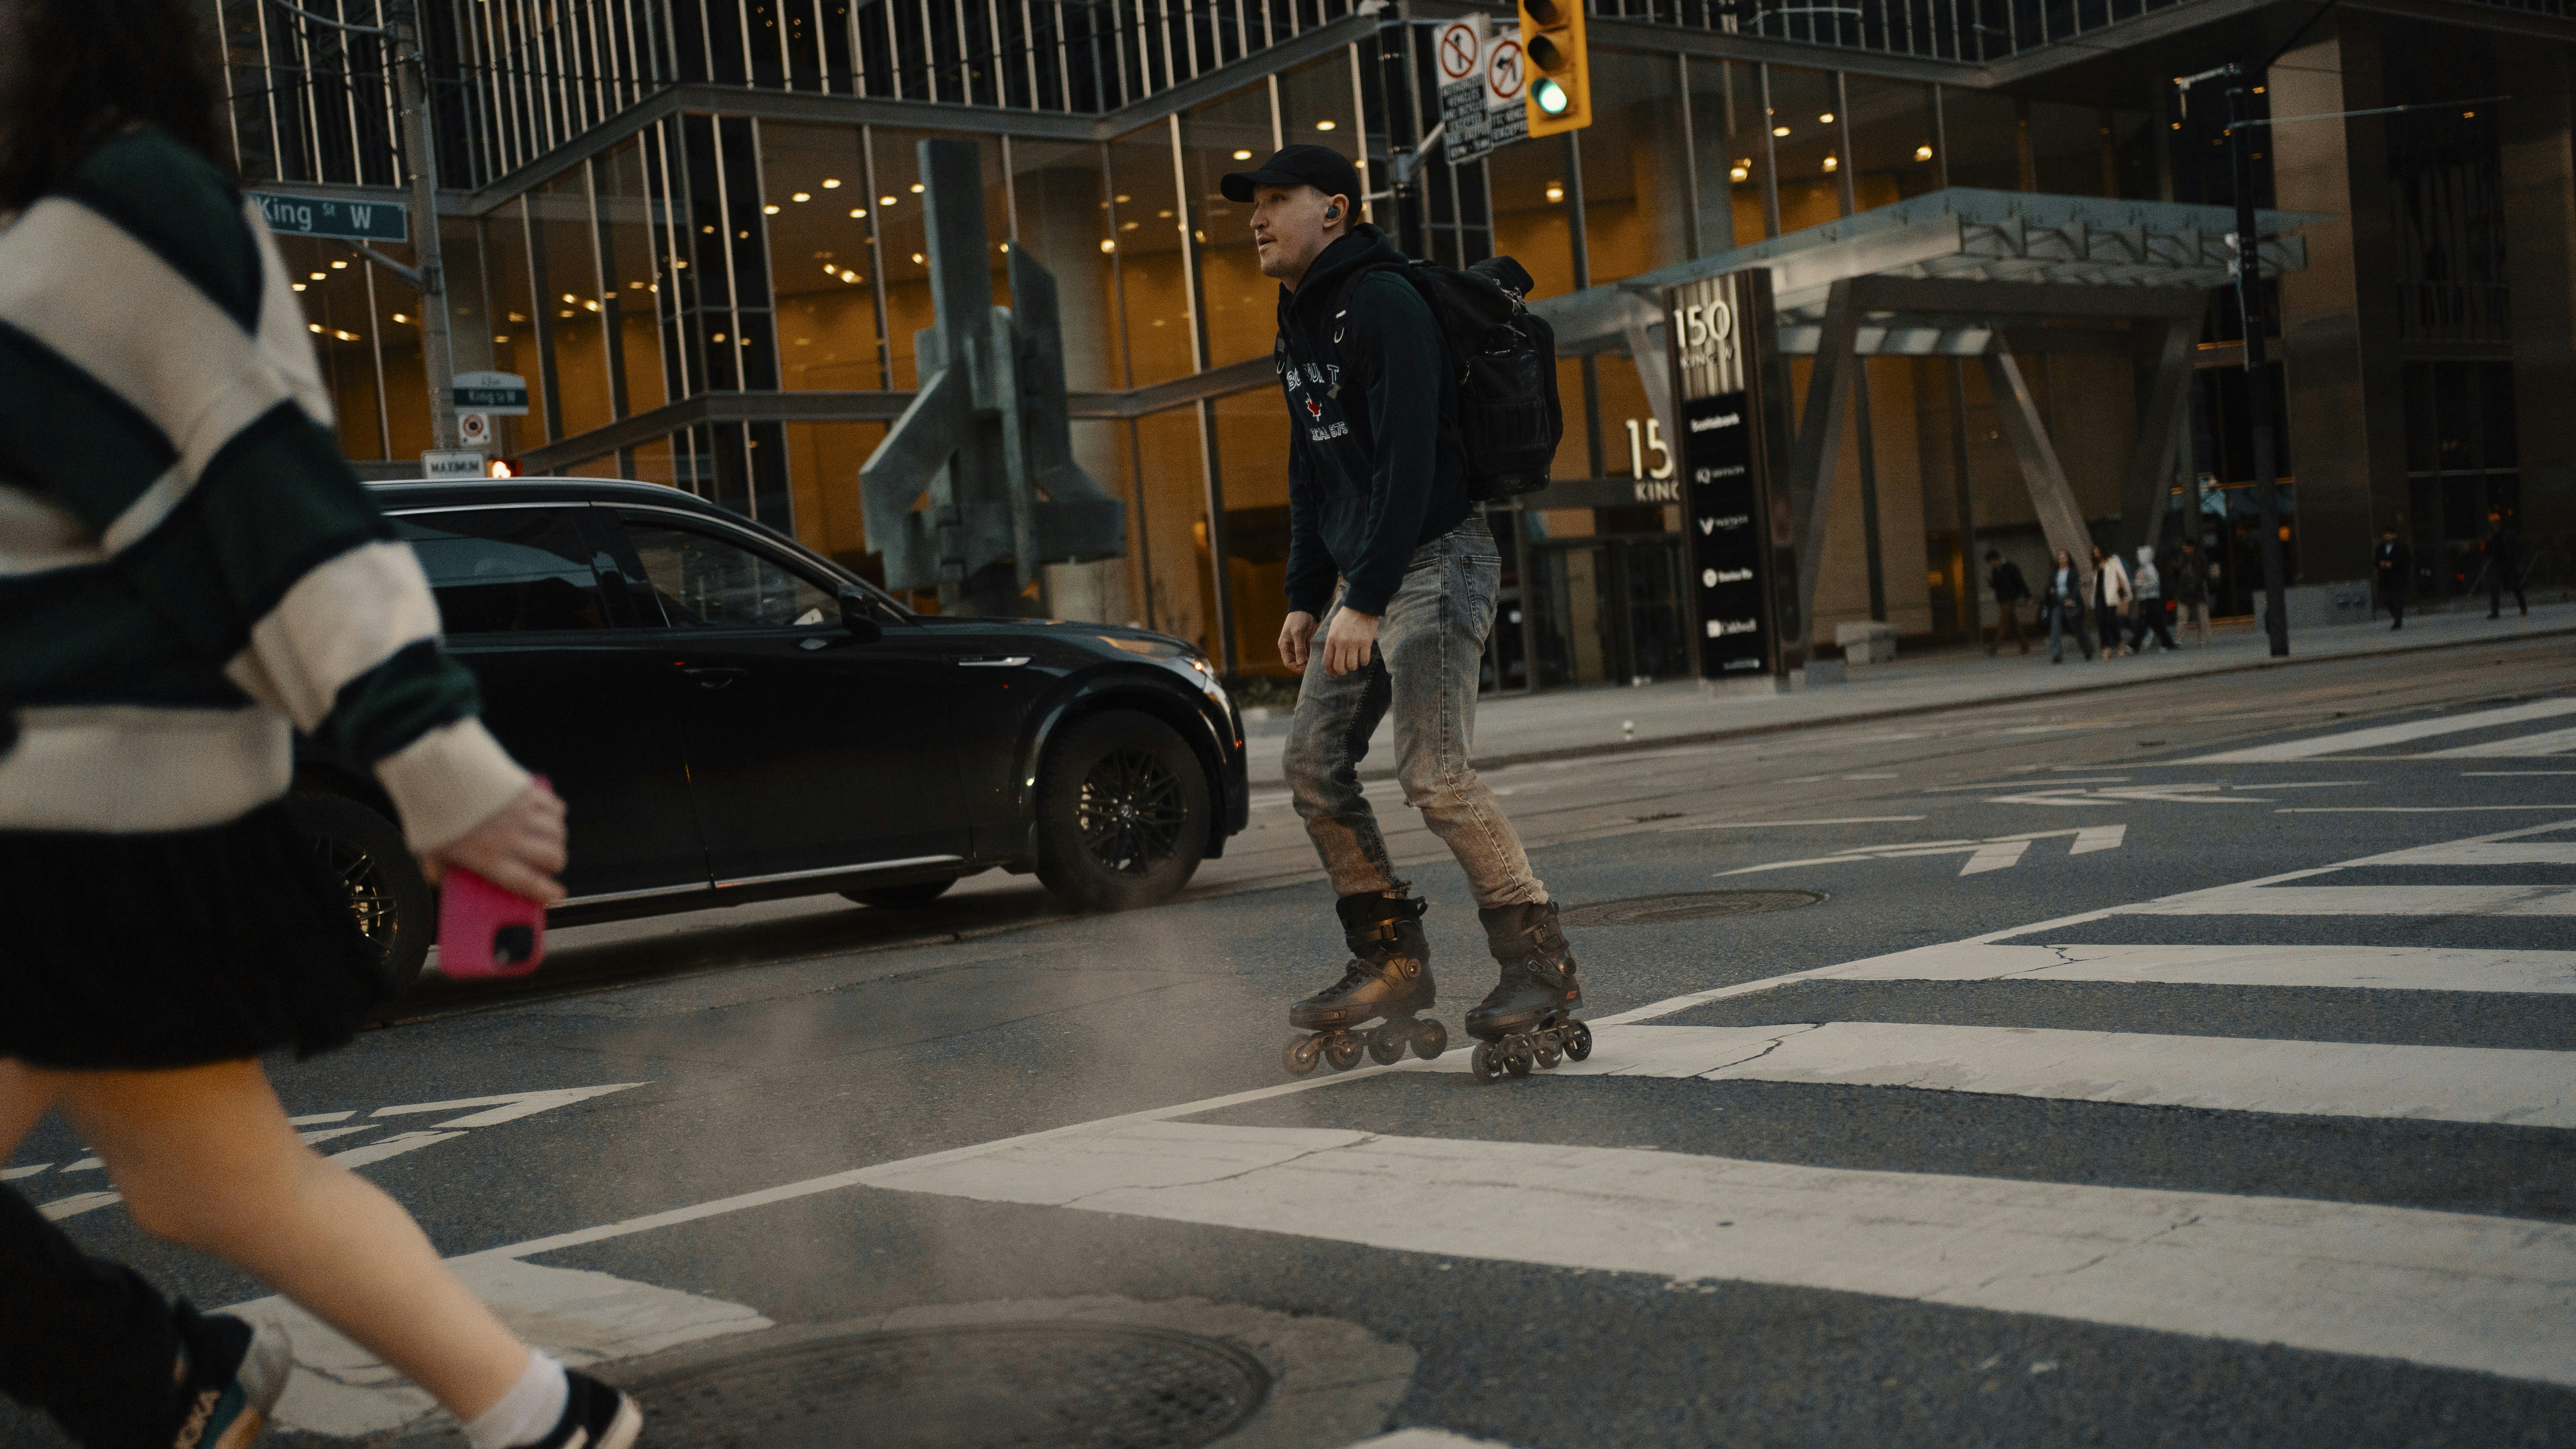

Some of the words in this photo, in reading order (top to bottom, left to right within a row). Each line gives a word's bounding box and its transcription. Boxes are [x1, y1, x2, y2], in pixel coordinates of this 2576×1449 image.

[1447, 89, 1480, 107] VEHICLES
[1493, 121, 1529, 140] EXCEPTE
[259, 195, 312, 232] King
[322, 201, 335, 217] St
[350, 205, 371, 230] W
[1674, 299, 1730, 348] 150
[469, 390, 494, 406] King
[1329, 421, 1348, 437] 675
